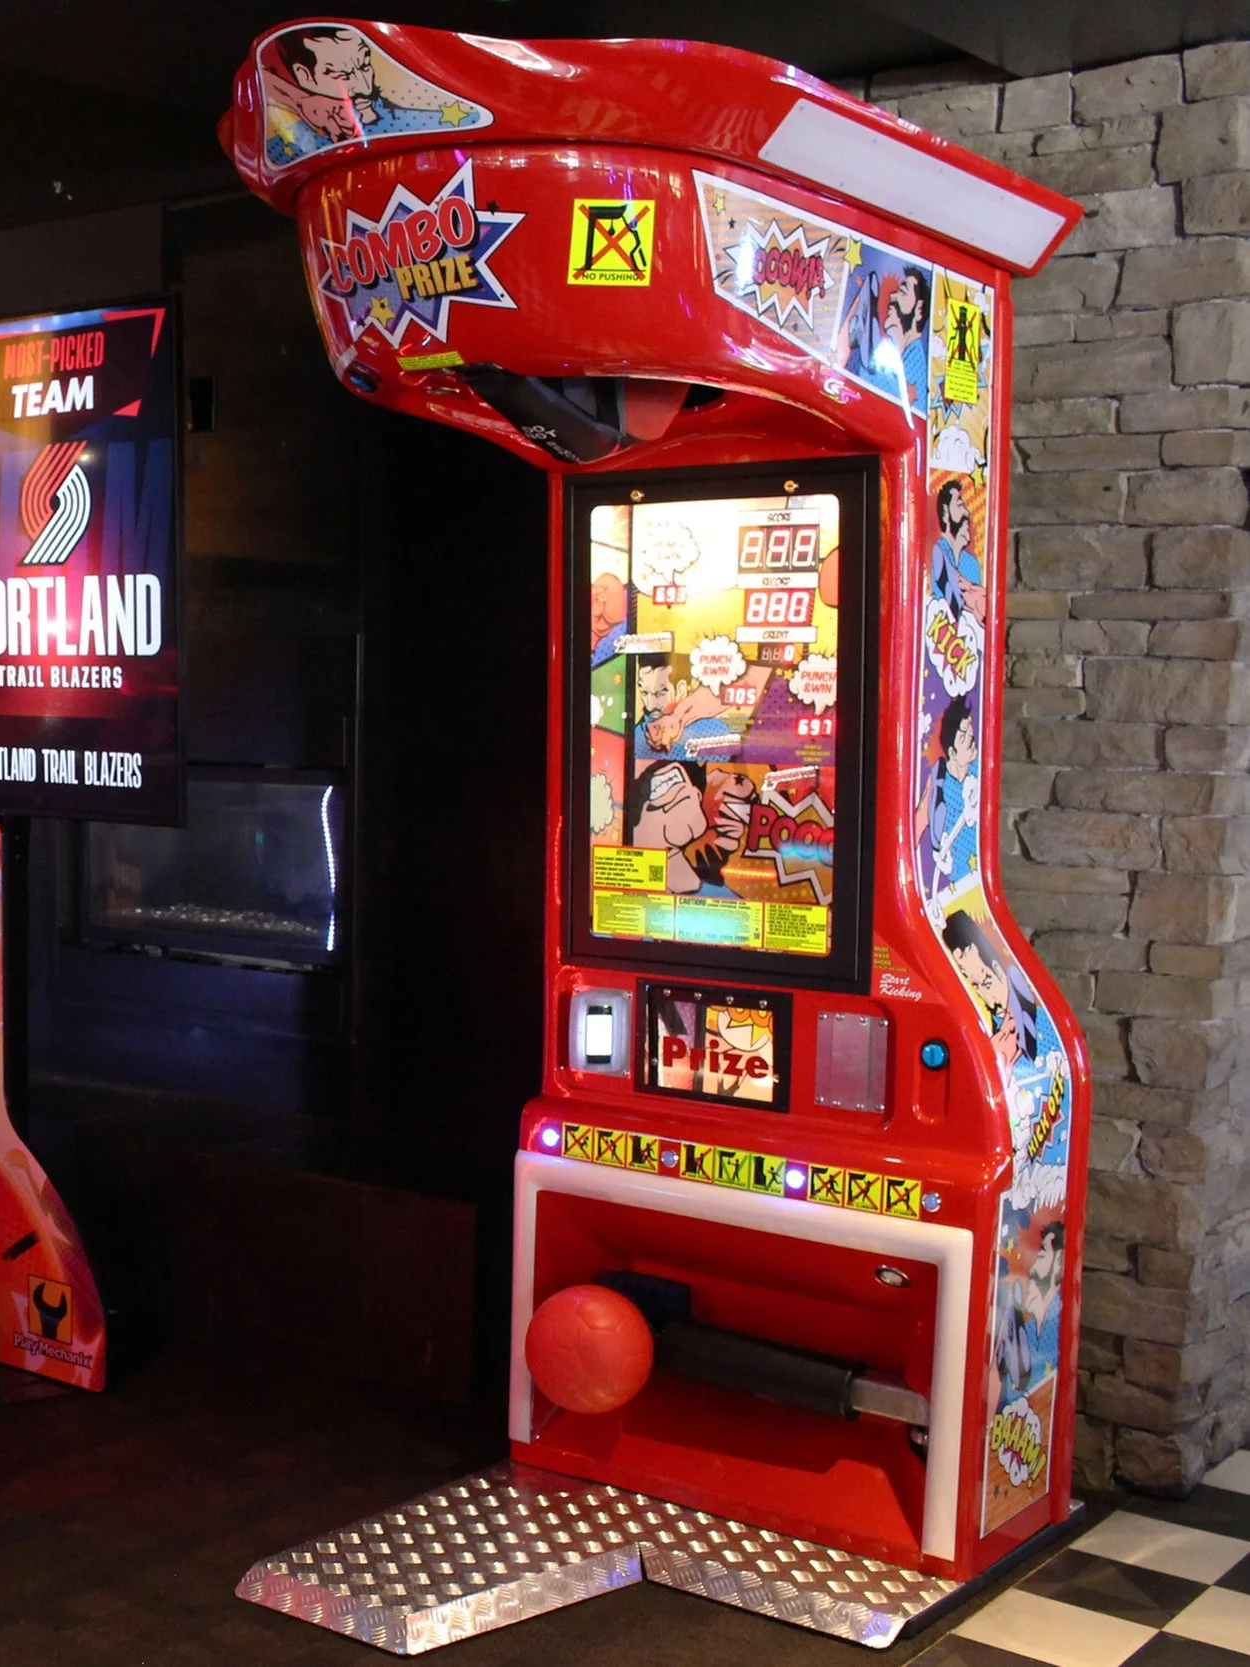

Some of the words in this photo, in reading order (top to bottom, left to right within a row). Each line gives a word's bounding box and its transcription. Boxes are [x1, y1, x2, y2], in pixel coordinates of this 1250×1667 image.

[328, 196, 477, 292] COMBO
[395, 255, 478, 300] PRIZE
[582, 273, 597, 281] NO
[4, 331, 105, 379] MOST-PICKED
[11, 376, 94, 419] TEAM
[927, 610, 977, 681] KICK
[699, 654, 733, 664] PUNCH
[701, 665, 730, 676] &WIN
[49, 664, 123, 689] BLAZERS
[801, 670, 837, 682] PUNCH
[803, 683, 833, 694] &WIN
[41, 748, 79, 786] TRAIL
[84, 751, 142, 789] BLAZERS
[879, 973, 911, 986] Start
[879, 983, 923, 1002] Kicking
[662, 1035, 769, 1080] Prize
[14, 1332, 39, 1356] Play
